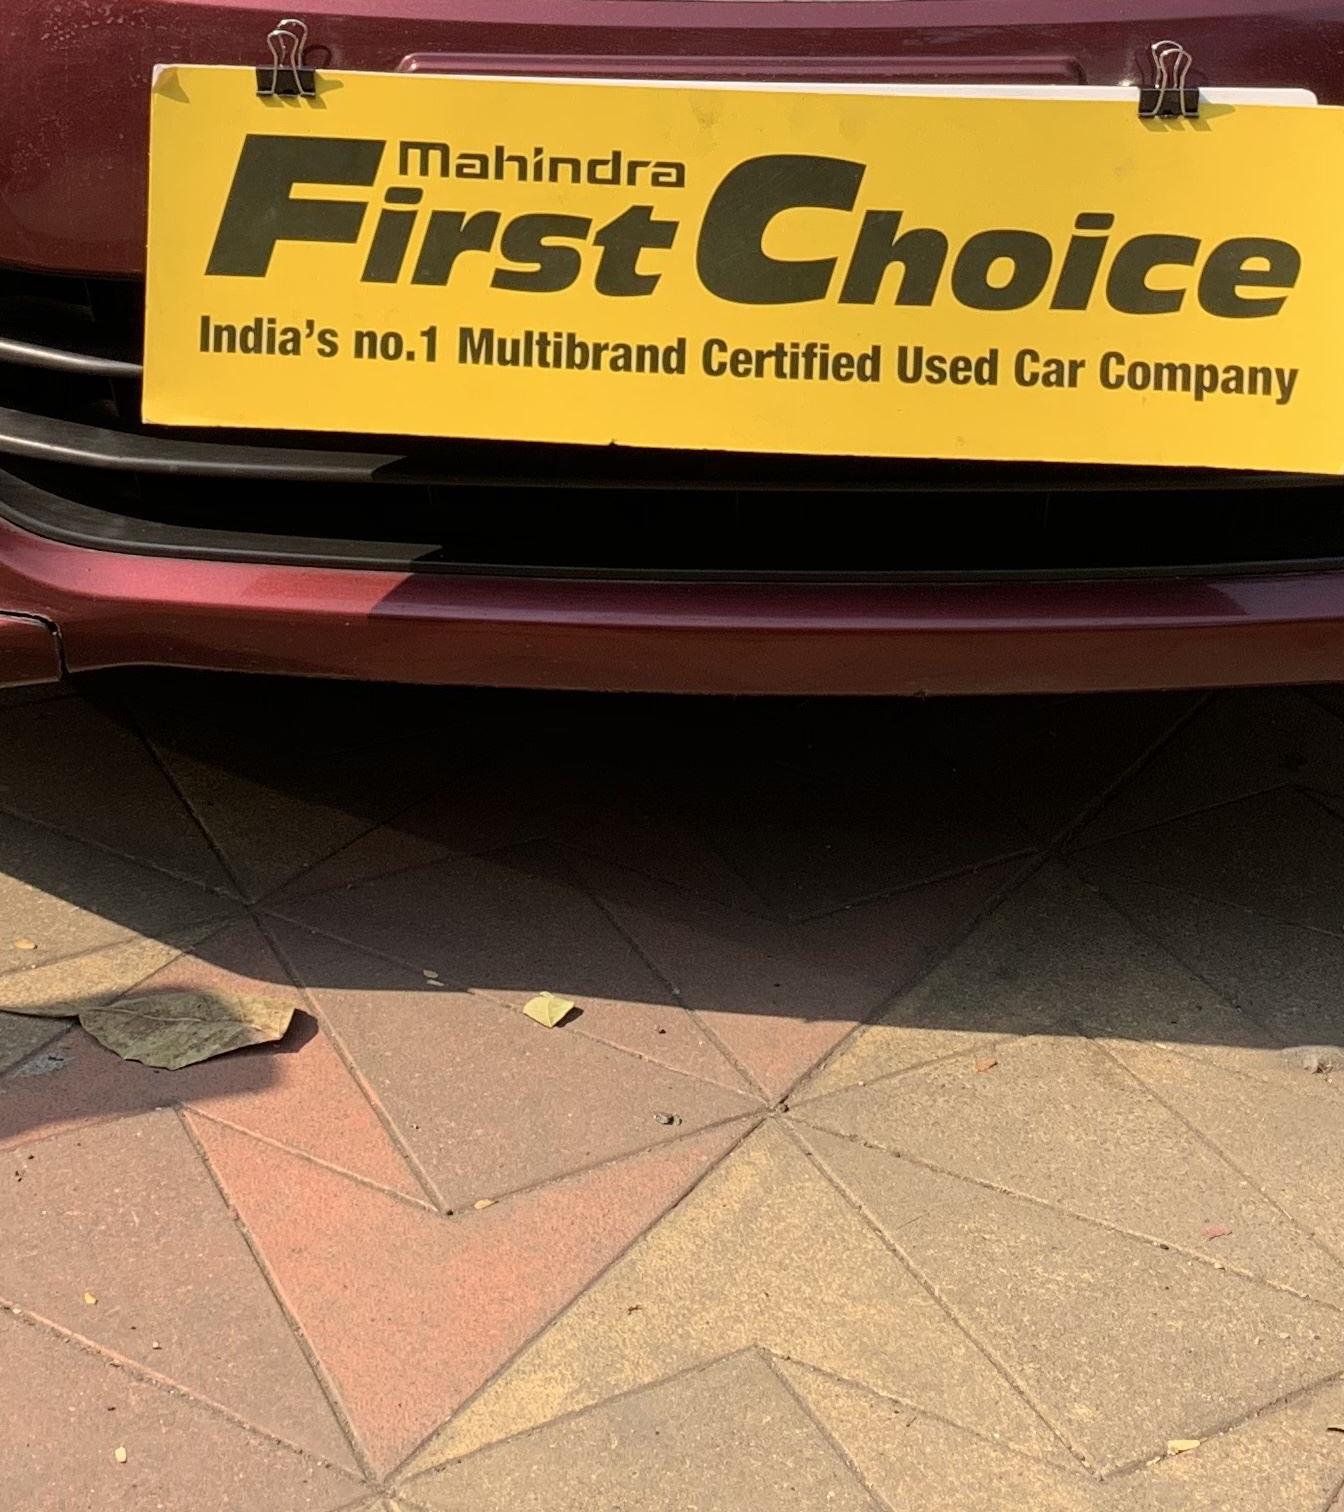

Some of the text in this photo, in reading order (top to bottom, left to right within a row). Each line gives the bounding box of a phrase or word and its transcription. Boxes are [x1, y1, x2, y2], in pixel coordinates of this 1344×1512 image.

[399, 140, 685, 188] Mahindra
[205, 133, 1301, 319] First Choice
[199, 315, 1298, 405] India's no.1 Multibrand Certified Used Car Company
